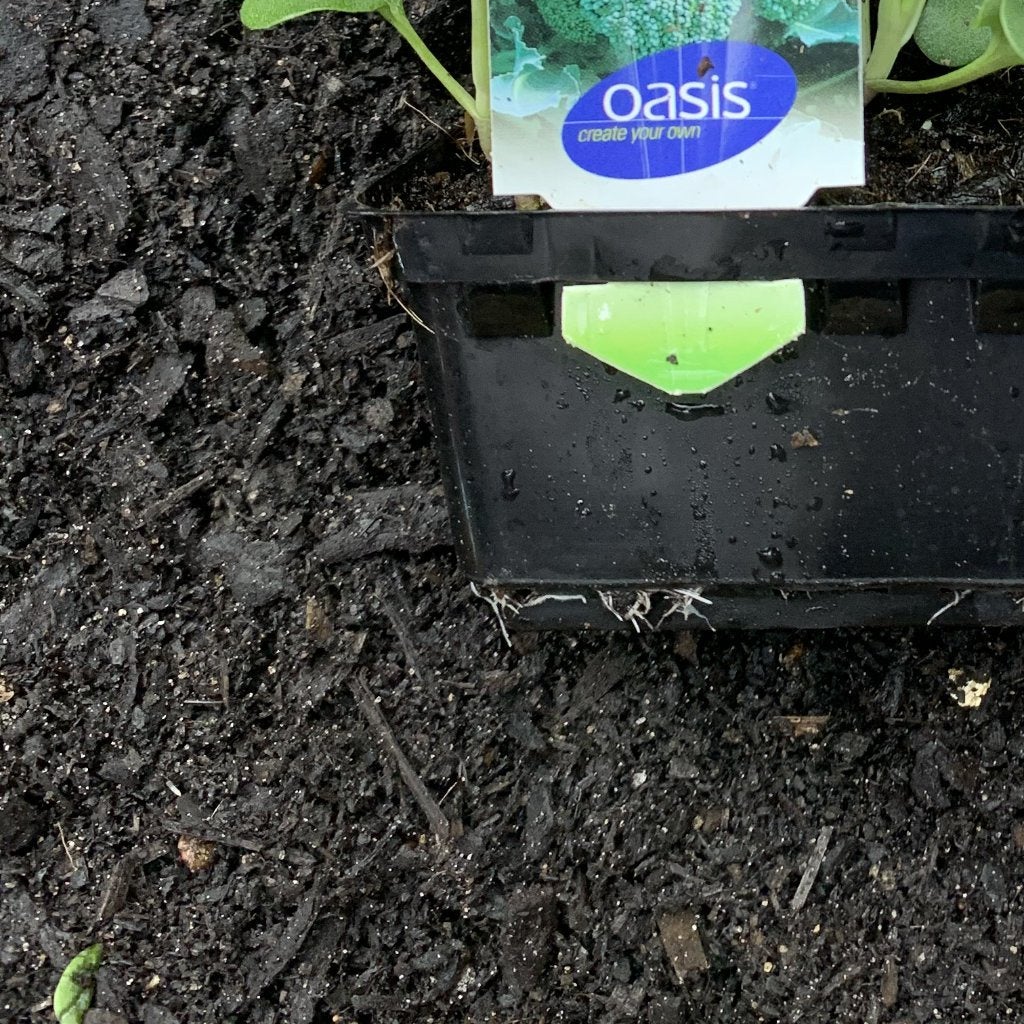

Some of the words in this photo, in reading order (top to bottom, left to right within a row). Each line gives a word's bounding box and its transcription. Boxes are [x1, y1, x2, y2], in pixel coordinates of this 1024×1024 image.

[603, 75, 751, 122] oasis
[577, 126, 628, 143] create
[631, 126, 664, 145] your
[667, 125, 701, 139] own
